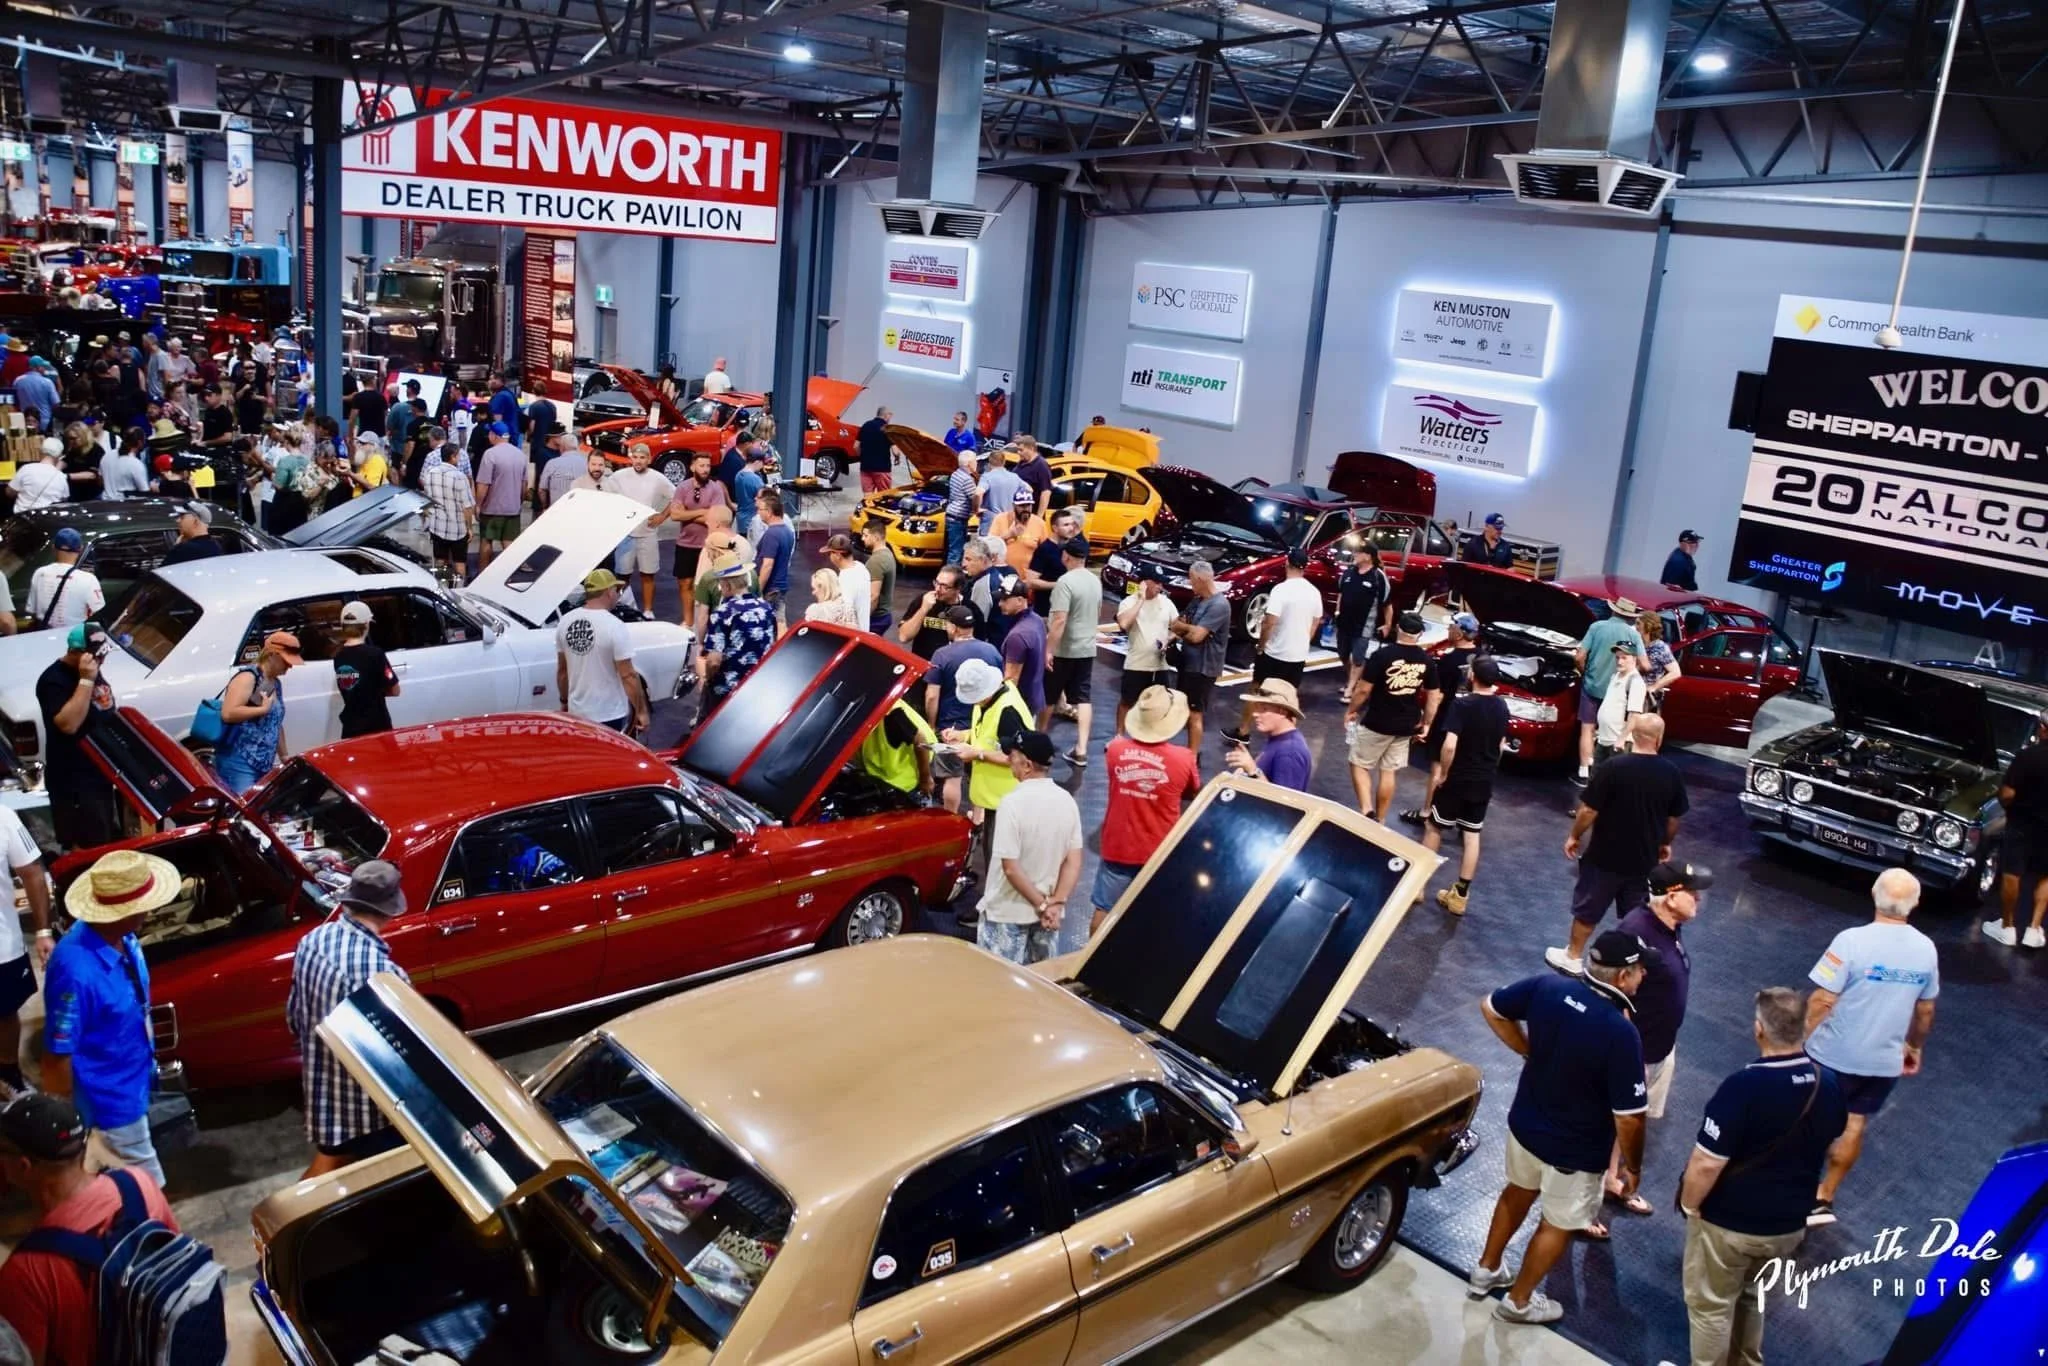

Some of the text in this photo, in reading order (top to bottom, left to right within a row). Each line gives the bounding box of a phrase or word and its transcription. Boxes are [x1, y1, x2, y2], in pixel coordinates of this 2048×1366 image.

[433, 107, 767, 193] KENWORTH
[380, 180, 742, 231] DEALER TRUCK PAVILION
[920, 265, 958, 276] PRODUCTS
[1154, 286, 1239, 308] PSC GRIFFITHS
[1189, 301, 1233, 314] GOODALL
[1433, 300, 1511, 319] KEN MUSTON
[1435, 315, 1504, 333] AUTOMOTIVE
[901, 327, 955, 347] BRIDGESTONE
[1450, 336, 1466, 347] Jeep
[1937, 326, 1975, 343] Bank
[1130, 368, 1227, 392] nti TRANSPORT
[1154, 382, 1193, 395] INSURANCE
[1869, 368, 2048, 418] WELCO
[1419, 415, 1490, 445] Watters
[1786, 408, 2020, 461] SHEPPARTON
[1419, 435, 1486, 455] Electrical
[1771, 465, 1865, 515] 20
[1833, 490, 1848, 500] TH
[1869, 508, 2048, 550] NATIONA
[1748, 560, 1820, 583] SHEPPARTON
[1771, 553, 1822, 572] GREATER
[1824, 830, 1867, 850] 8904 H4
[443, 886, 462, 899] 034
[930, 1250, 953, 1270] 035
